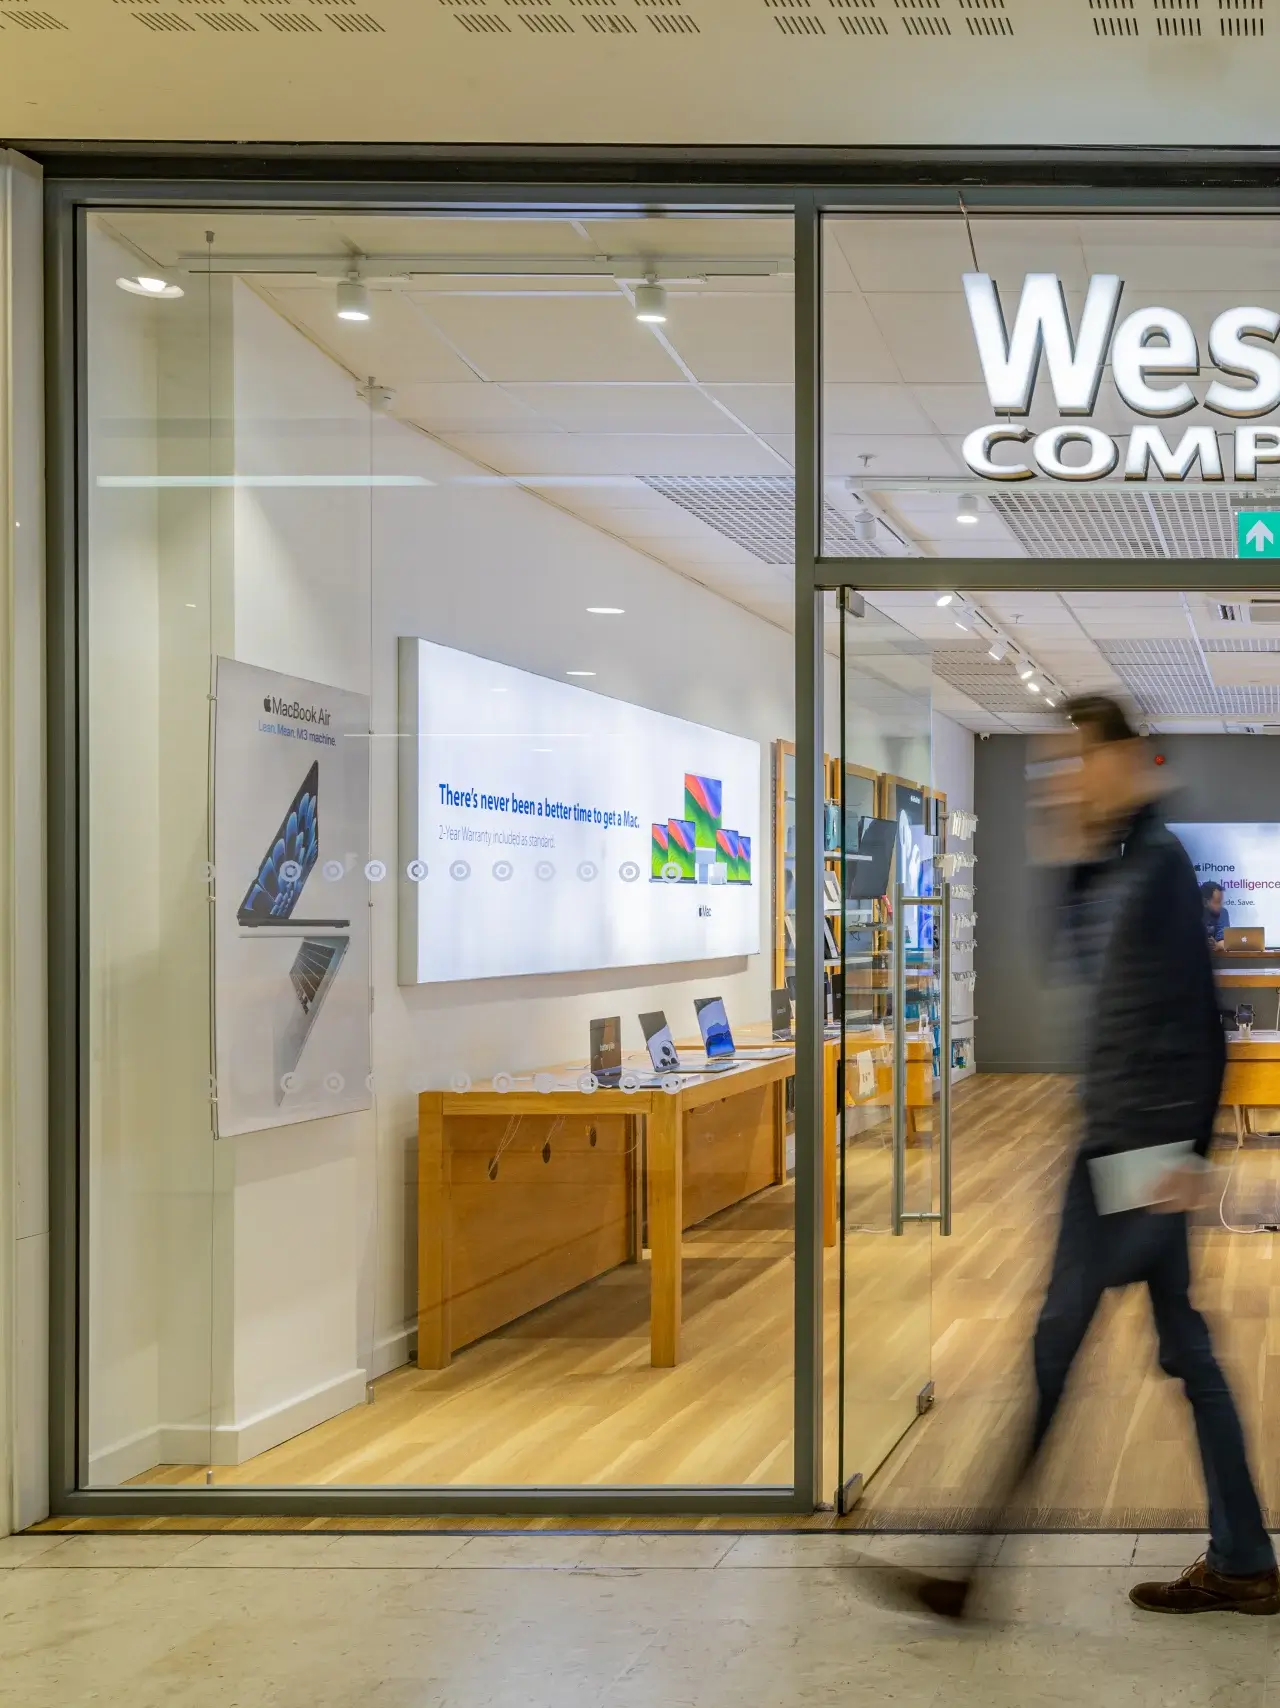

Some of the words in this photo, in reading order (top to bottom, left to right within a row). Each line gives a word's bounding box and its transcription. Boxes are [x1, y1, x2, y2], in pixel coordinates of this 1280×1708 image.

[272, 696, 317, 724] MacBook
[318, 707, 331, 726] Air
[258, 720, 276, 734] Lean.
[277, 723, 296, 738] Mean.
[296, 728, 308, 741] M3
[309, 732, 337, 747] machine.
[439, 783, 479, 809] There's
[480, 794, 510, 812] never
[511, 792, 536, 816] been
[537, 801, 543, 817] a
[544, 797, 572, 820] better
[573, 803, 592, 824] time
[593, 807, 602, 824] to
[603, 810, 616, 829] get
[617, 812, 622, 827] a
[623, 810, 640, 829] Mac.
[438, 824, 461, 841] 2-Year
[461, 826, 493, 847] Warranty
[1202, 862, 1236, 872] iPhone
